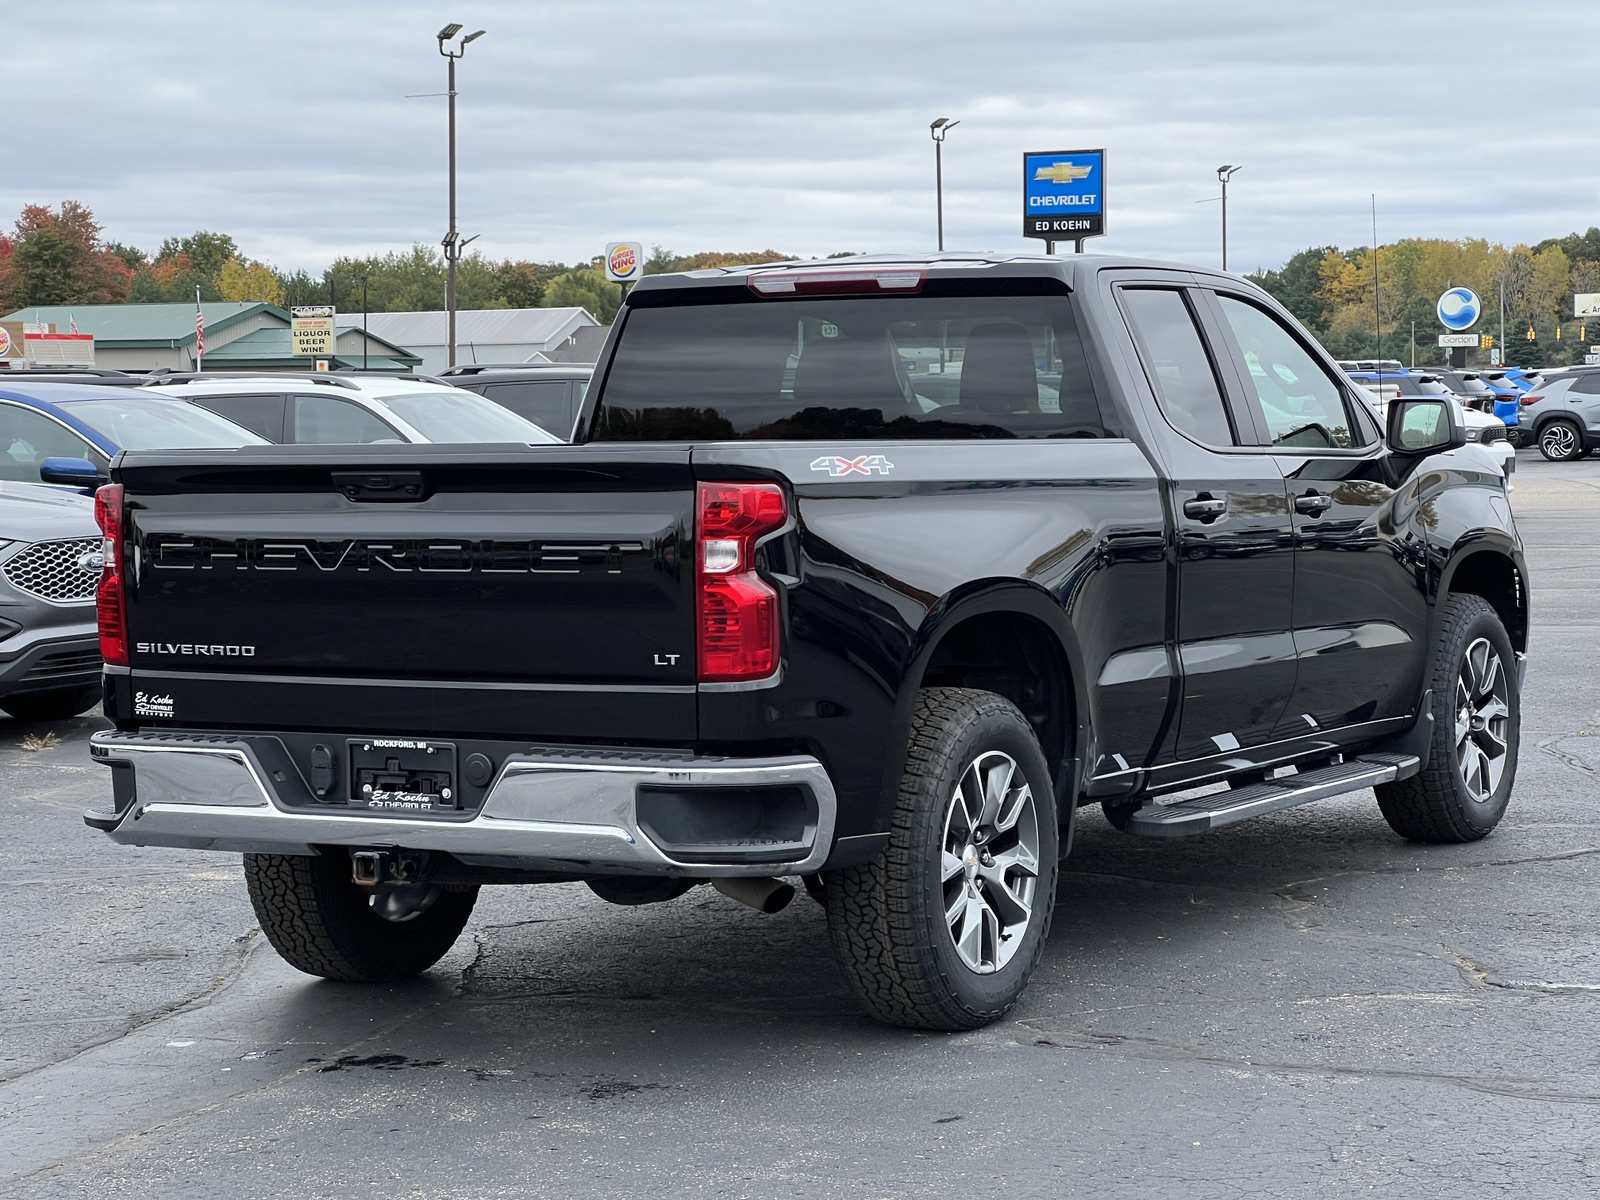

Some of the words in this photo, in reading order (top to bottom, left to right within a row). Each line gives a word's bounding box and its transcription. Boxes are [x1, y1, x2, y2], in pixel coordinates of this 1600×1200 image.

[1030, 194, 1096, 206] CHEVROLET
[1035, 221, 1049, 231] ED
[1053, 220, 1090, 230] KOEHN
[611, 250, 634, 261] BURGER
[612, 256, 635, 271] KING
[153, 539, 642, 573] CHEVROLET
[136, 643, 255, 656] SILVERADO
[653, 654, 680, 665] LT
[135, 691, 148, 703] Ed
[150, 694, 174, 704] Koehn
[374, 740, 416, 749] ROCKFORD,
[371, 790, 390, 800] Ed
[394, 791, 430, 802] Koehn
